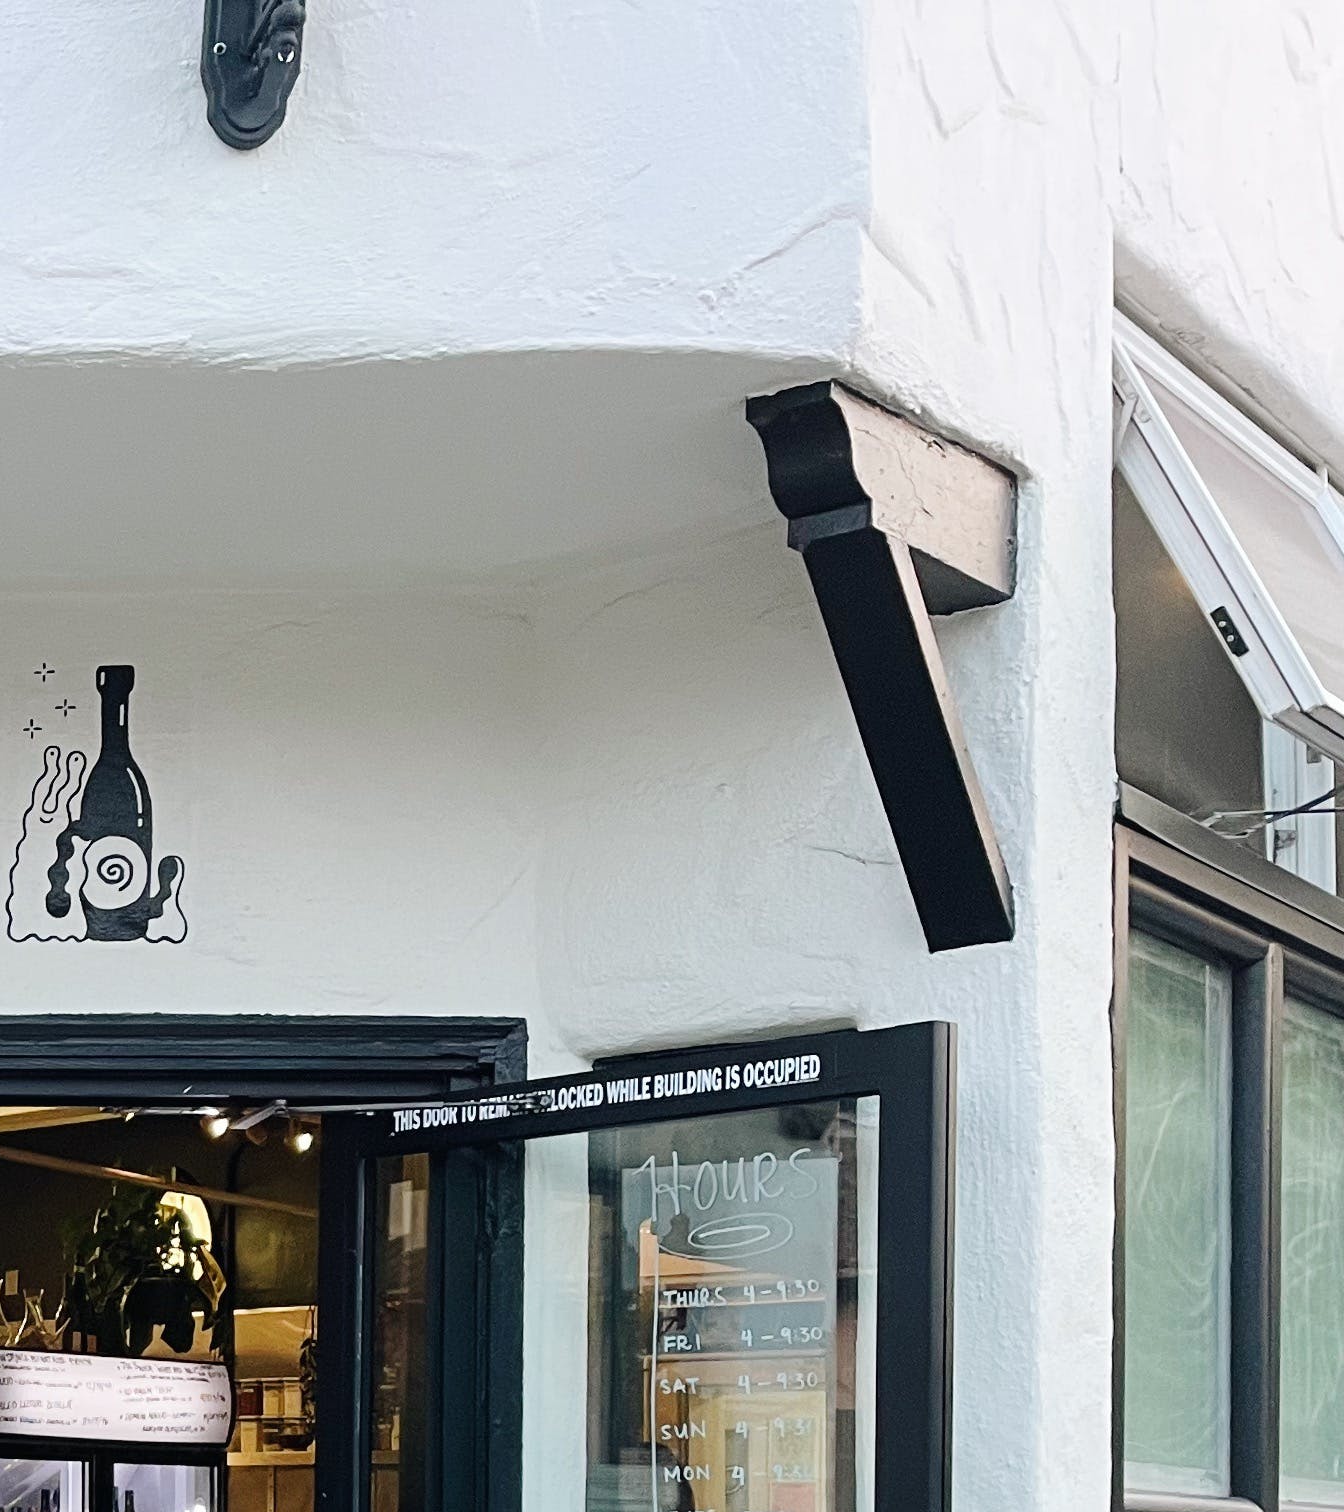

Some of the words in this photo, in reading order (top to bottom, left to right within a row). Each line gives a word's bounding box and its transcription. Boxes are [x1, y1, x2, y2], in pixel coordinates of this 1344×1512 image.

[393, 1109, 420, 1132] THIS
[530, 1085, 604, 1114] LOCKED
[606, 1076, 651, 1104] WHILE
[654, 1067, 722, 1099] BUILDING
[726, 1064, 740, 1089] IS
[743, 1054, 821, 1087] OCCUPIED
[632, 1148, 818, 1222] HOURS
[663, 1287, 727, 1307] THURS
[664, 1334, 701, 1353] FRI
[660, 1377, 700, 1395] SAT
[661, 1420, 706, 1441] SUN
[664, 1463, 711, 1483] MON
